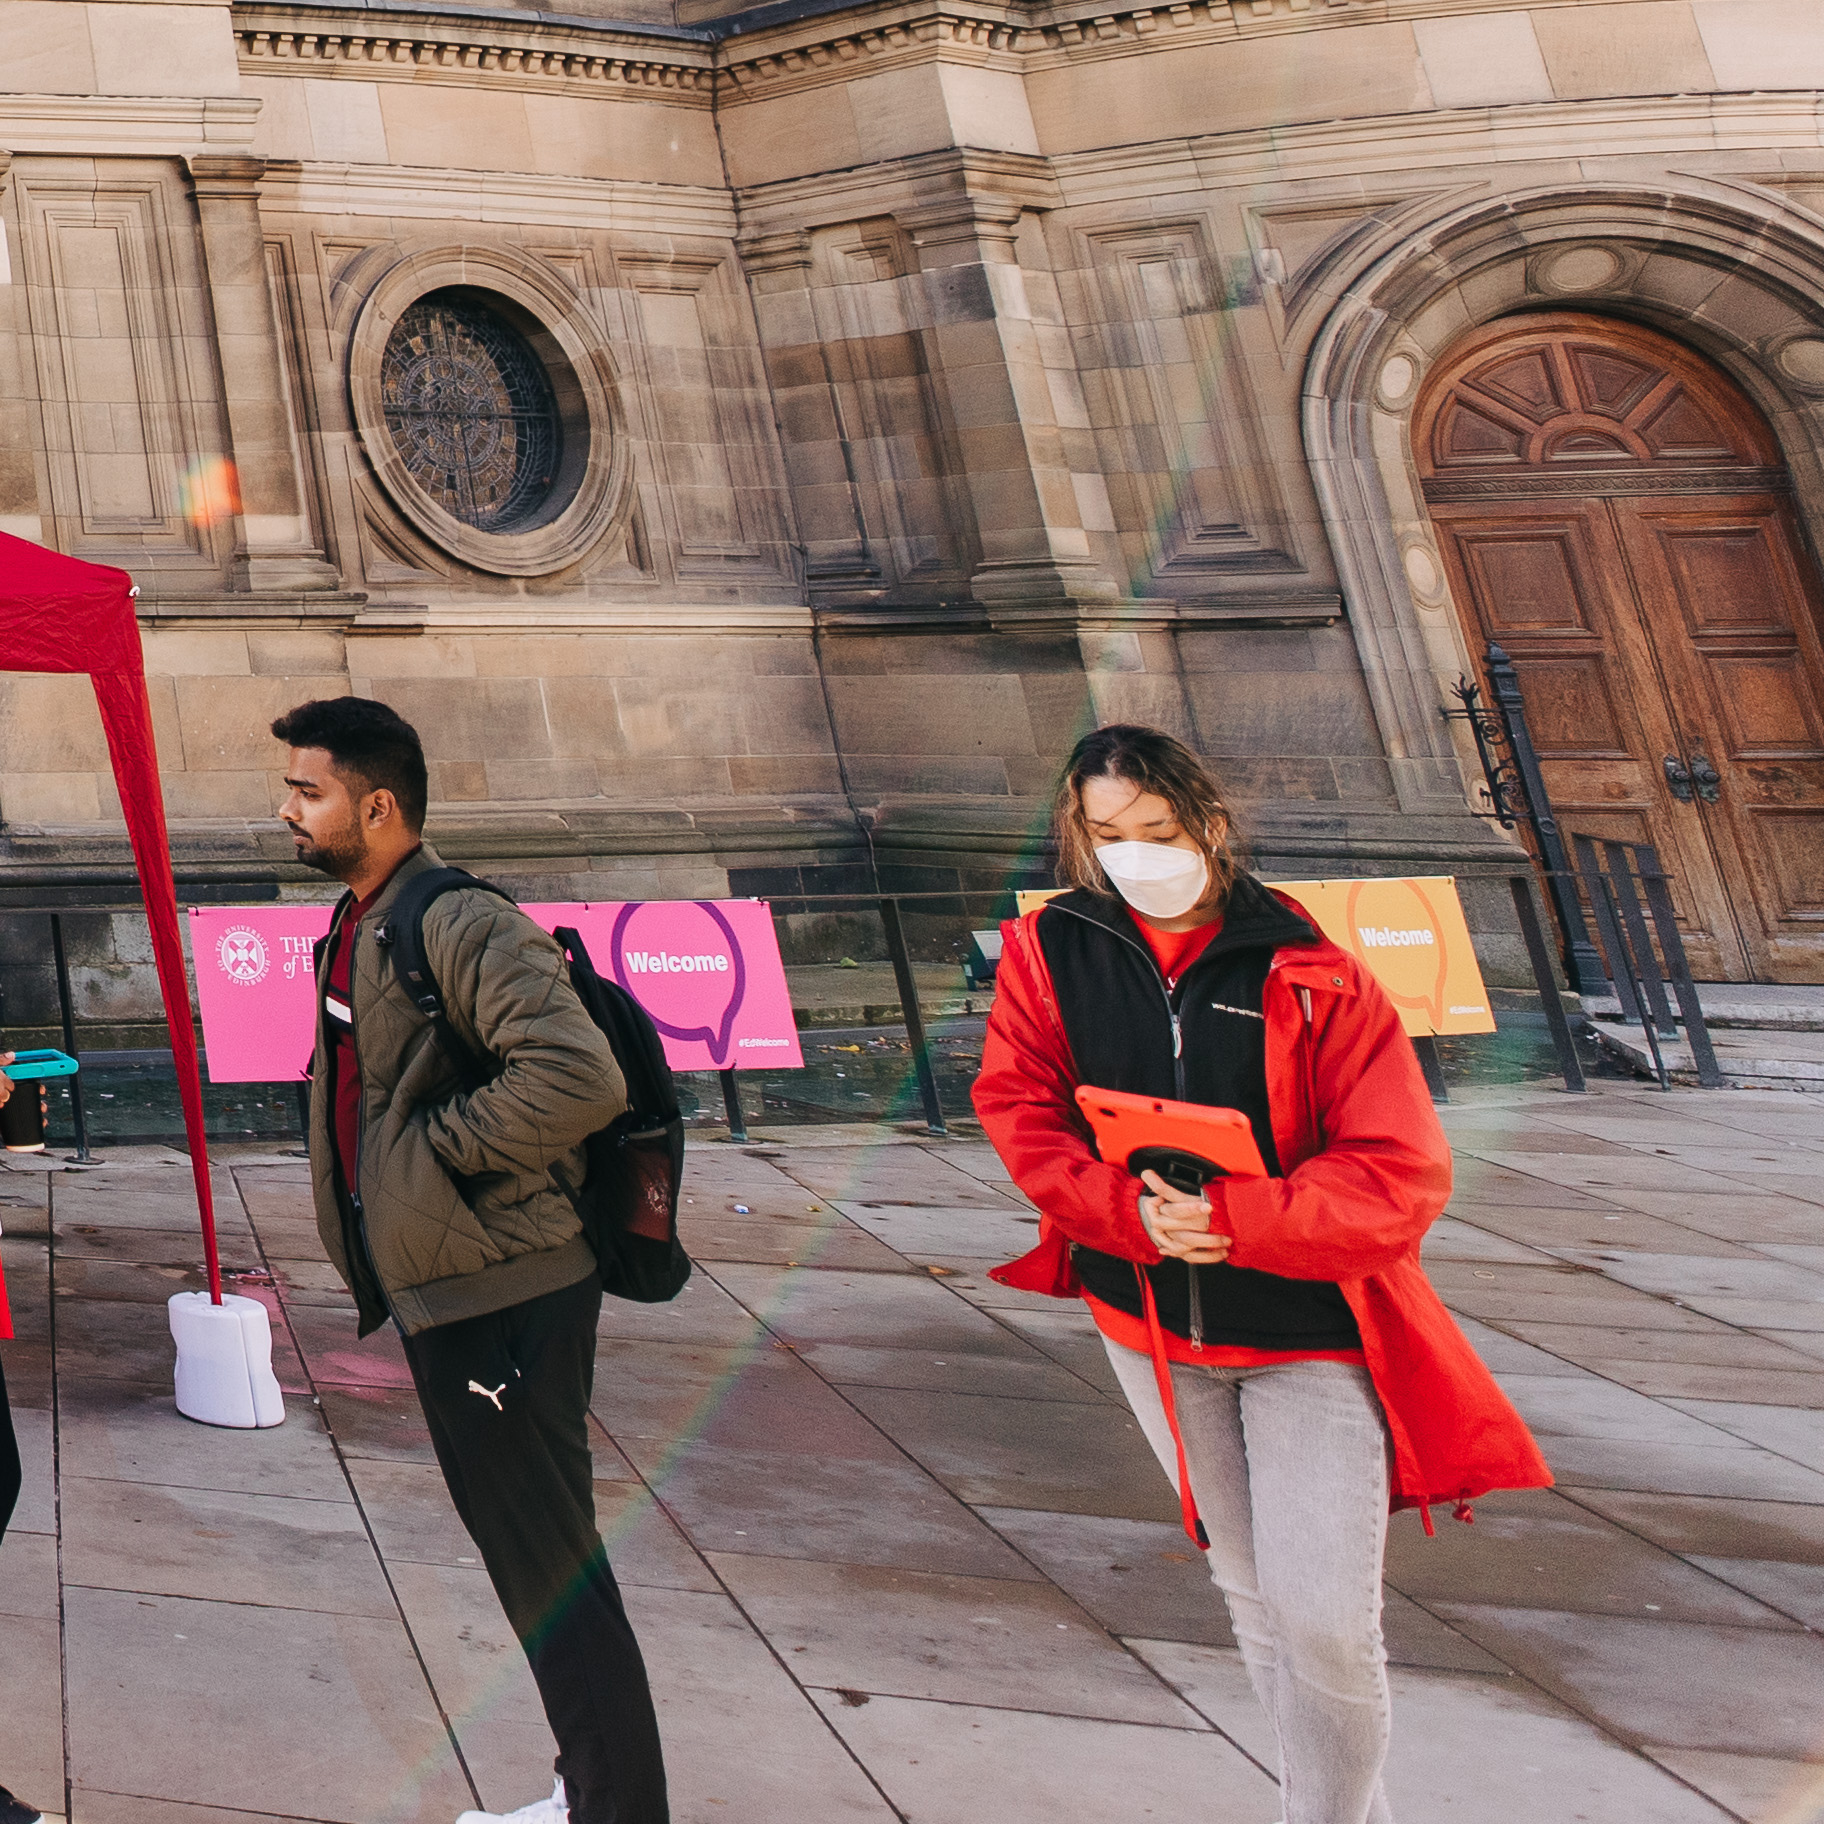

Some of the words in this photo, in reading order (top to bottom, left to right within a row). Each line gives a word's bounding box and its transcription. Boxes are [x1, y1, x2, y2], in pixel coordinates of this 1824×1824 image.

[1358, 926, 1434, 947] Welcome
[283, 955, 299, 979] of
[625, 951, 729, 974] Welcome
